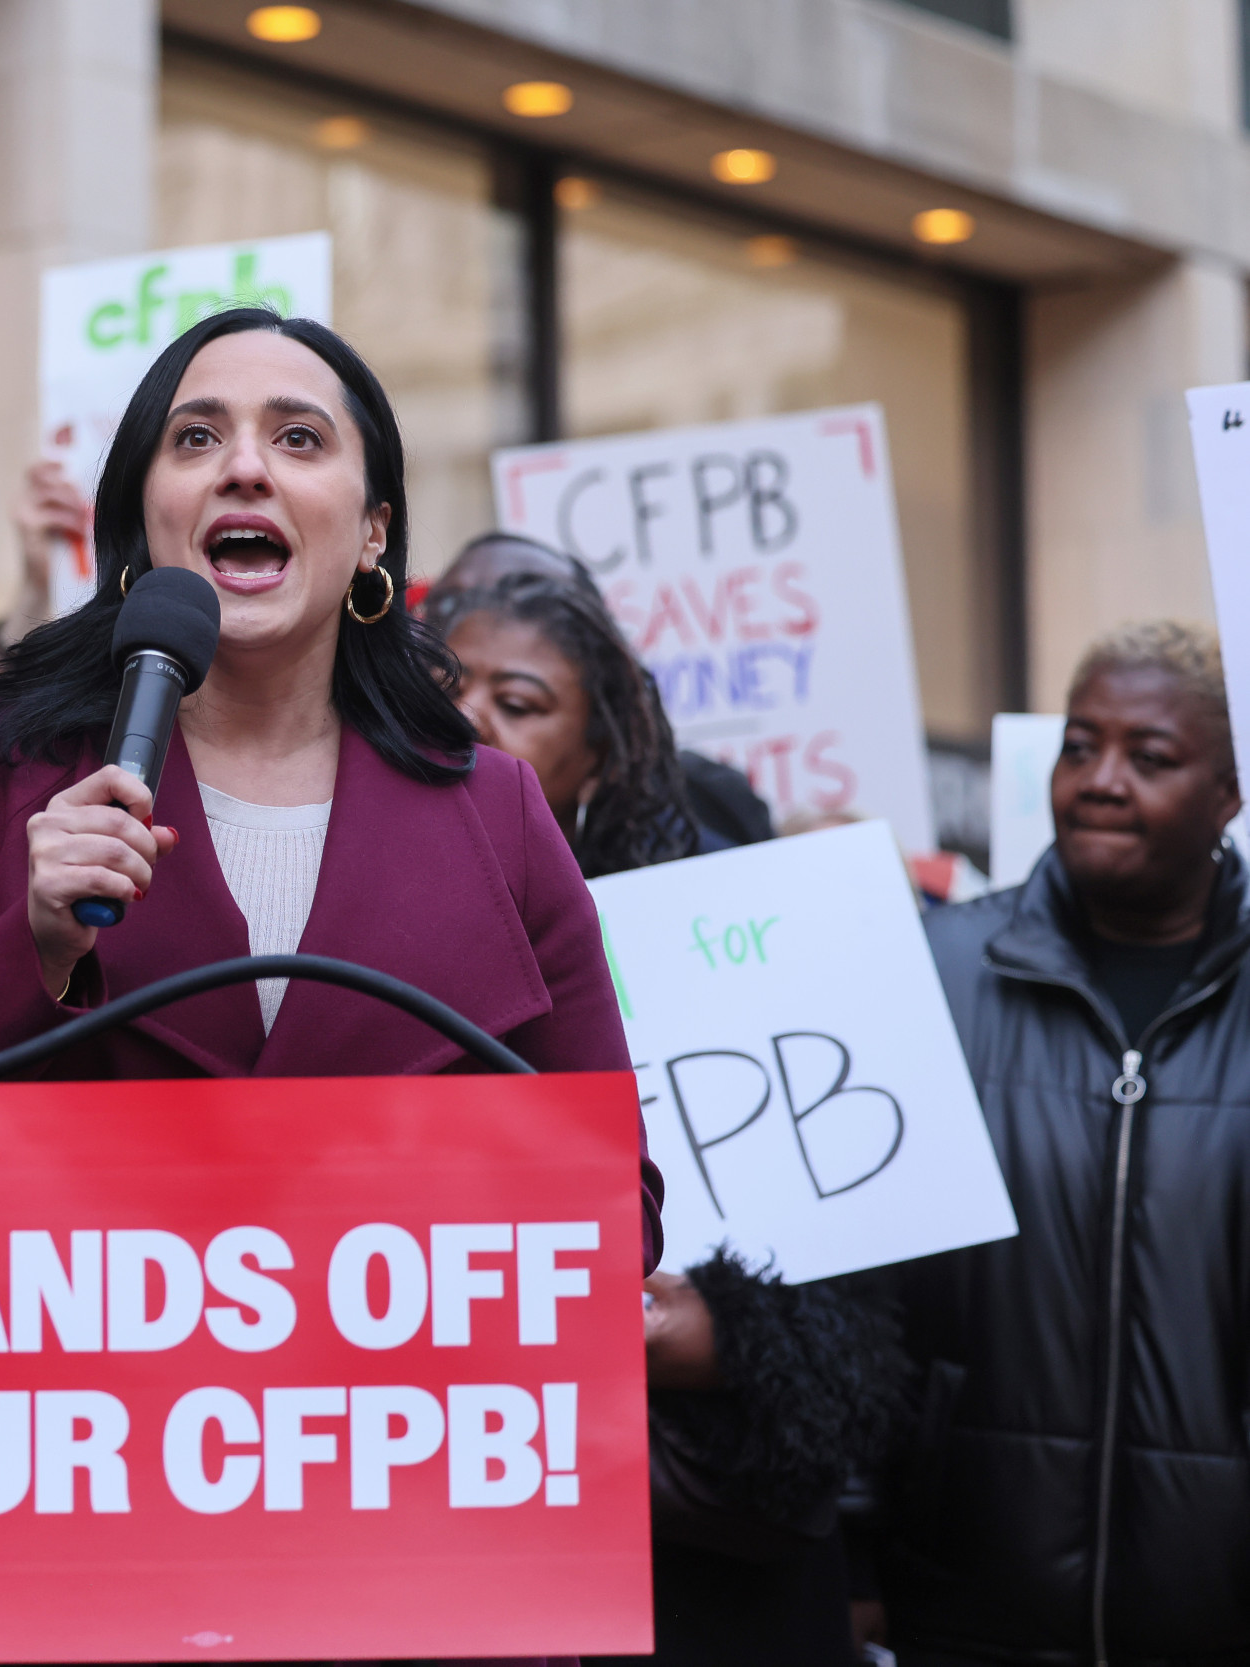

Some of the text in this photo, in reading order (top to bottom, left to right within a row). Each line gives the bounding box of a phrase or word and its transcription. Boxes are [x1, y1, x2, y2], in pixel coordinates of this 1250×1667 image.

[556, 448, 801, 573] CFPB
[609, 561, 820, 651] SAVES
[650, 643, 816, 718] ONEY
[689, 916, 780, 969] for
[327, 1221, 600, 1352] OFF
[162, 1382, 580, 1516] CFPB!
